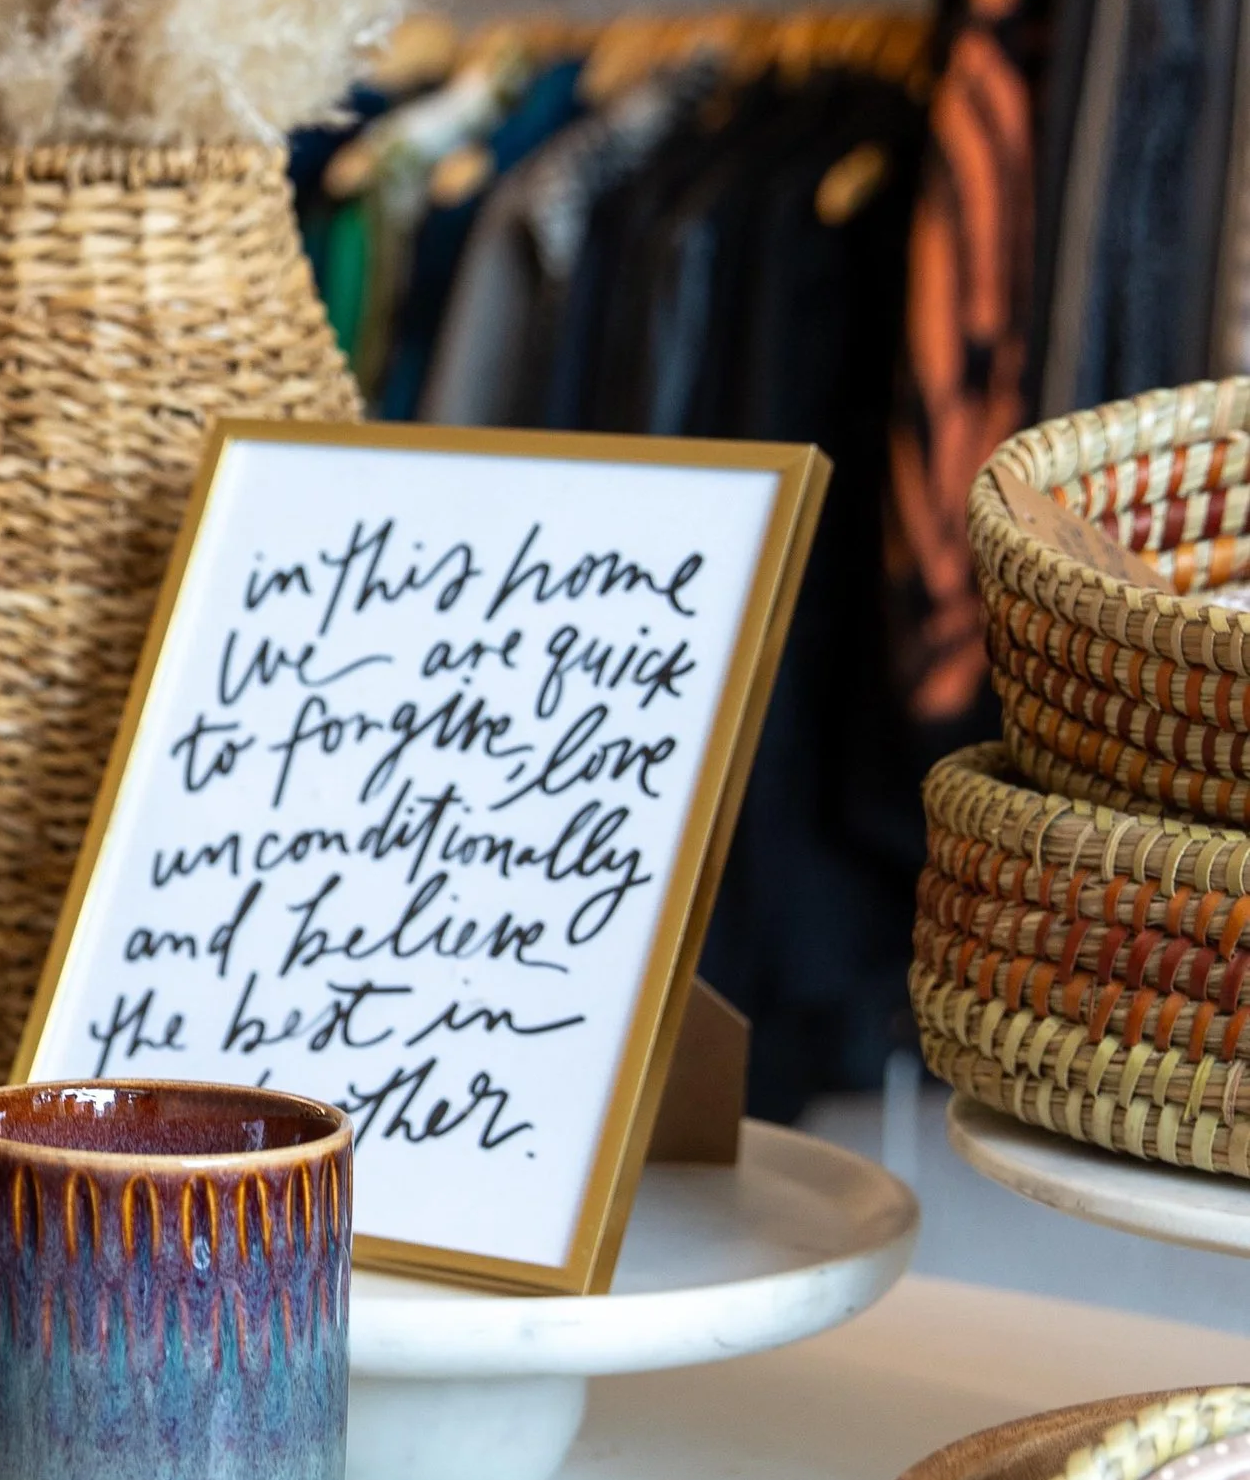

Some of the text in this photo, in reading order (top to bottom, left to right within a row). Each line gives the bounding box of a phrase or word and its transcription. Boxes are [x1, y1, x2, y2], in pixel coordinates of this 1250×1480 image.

[244, 519, 704, 635] in this home
[421, 635, 521, 679] are
[536, 625, 697, 719] quick
[171, 716, 257, 793] to
[490, 703, 679, 811] love
[153, 779, 653, 946] unconditionally
[124, 873, 570, 978] and believe
[88, 973, 586, 1079] the best in
